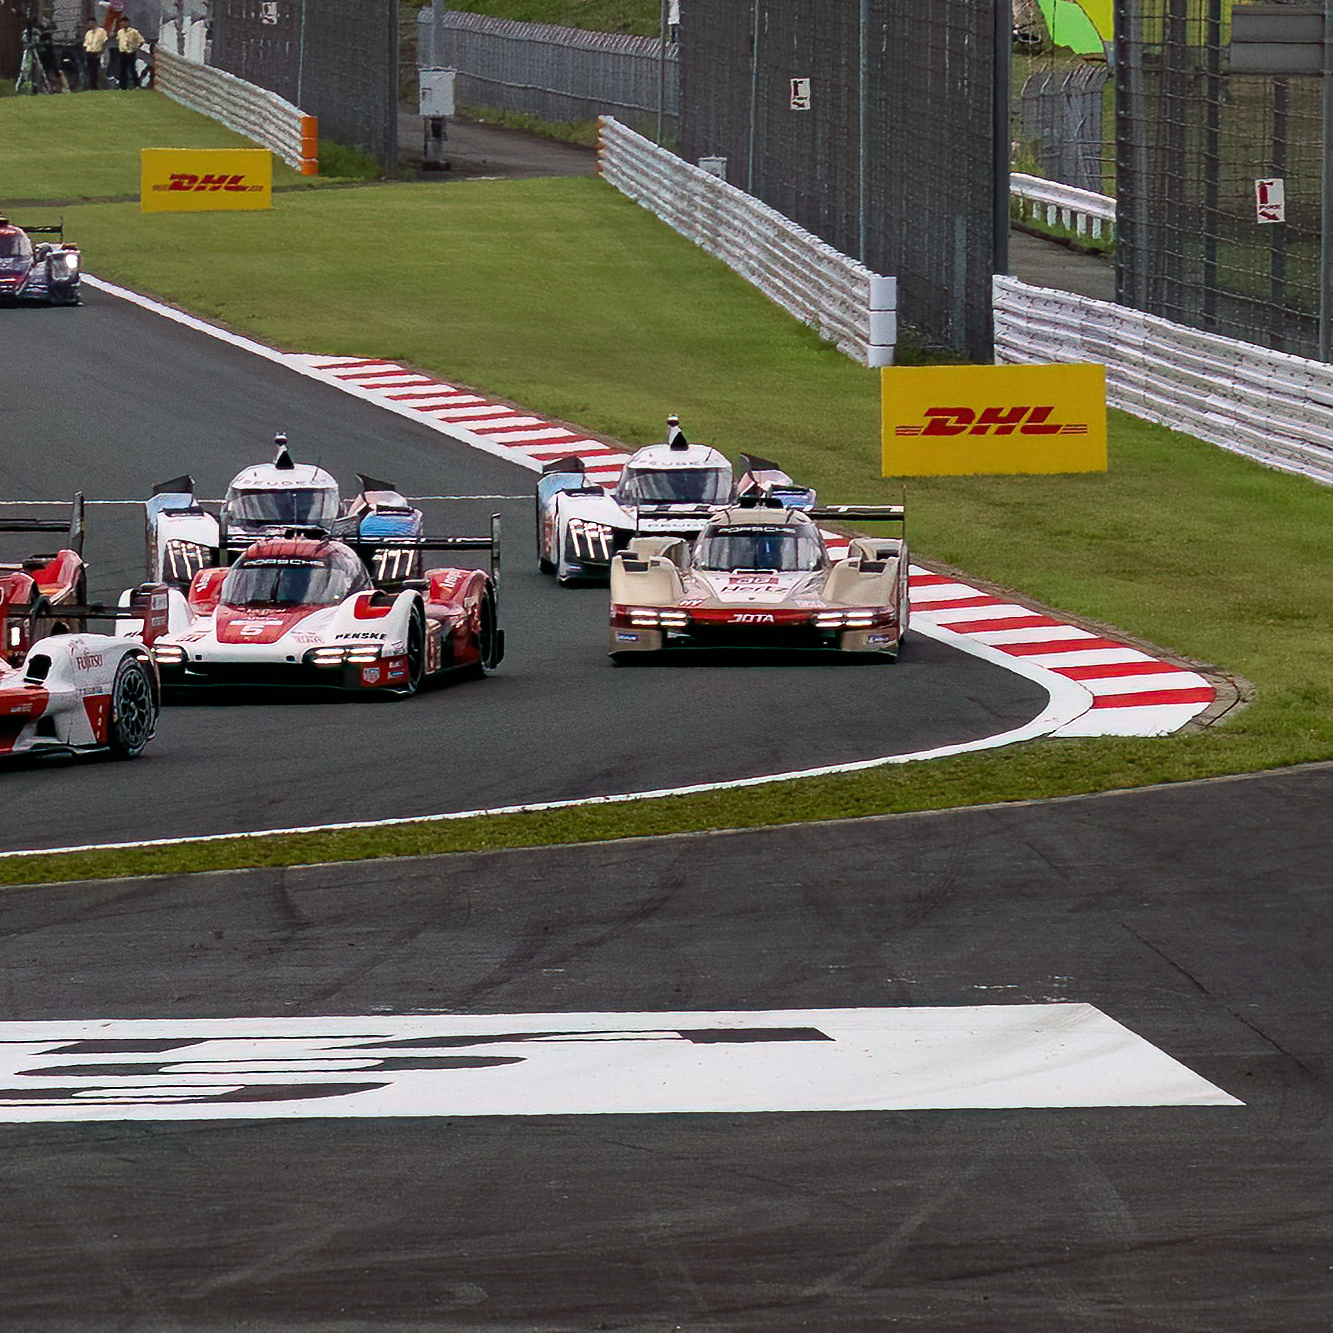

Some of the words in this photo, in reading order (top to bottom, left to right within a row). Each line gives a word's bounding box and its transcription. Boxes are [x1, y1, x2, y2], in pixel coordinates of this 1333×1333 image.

[168, 174, 248, 191] DHL
[920, 406, 1064, 435] DHL
[243, 559, 325, 567] PORSCHE
[727, 613, 775, 623] JOTA
[335, 632, 387, 641] PENSKE
